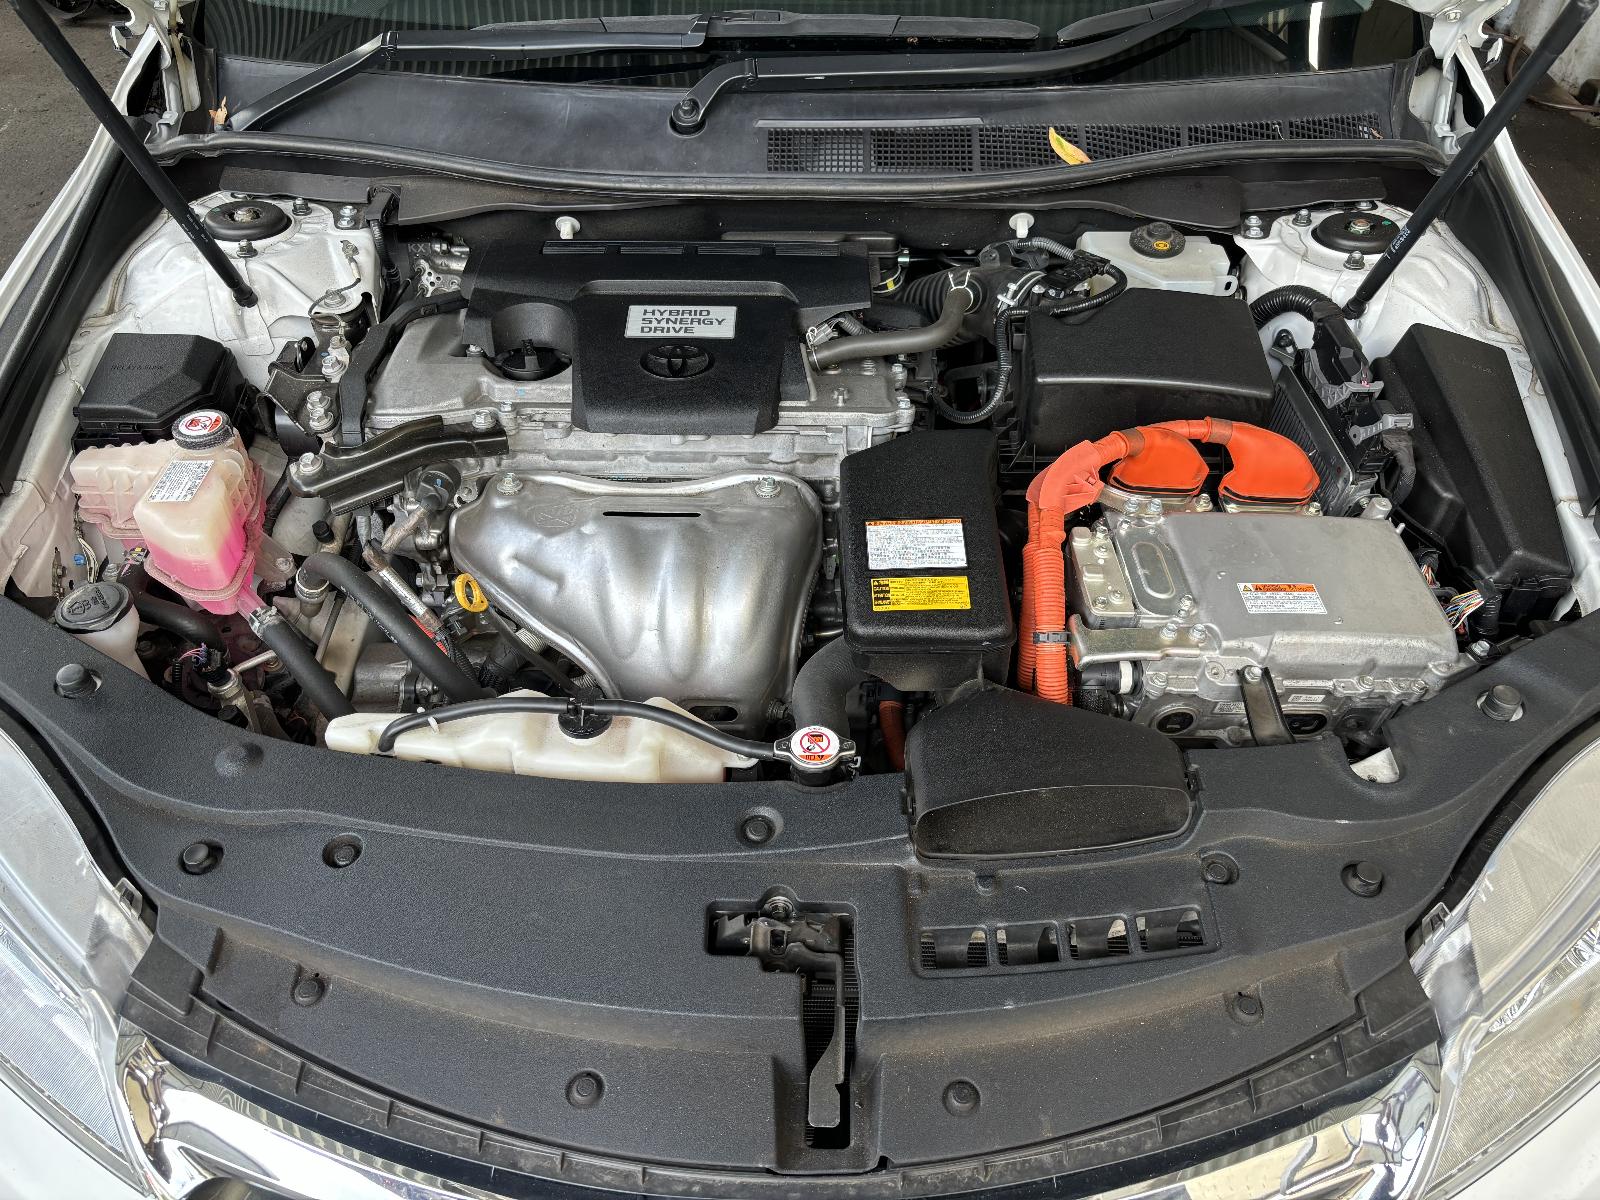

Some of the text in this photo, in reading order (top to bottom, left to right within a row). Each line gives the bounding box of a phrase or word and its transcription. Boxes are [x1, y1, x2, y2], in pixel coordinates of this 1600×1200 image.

[643, 309, 711, 317] HYBRID
[641, 317, 726, 325] SYNERGY
[640, 326, 695, 334] DRIVE
